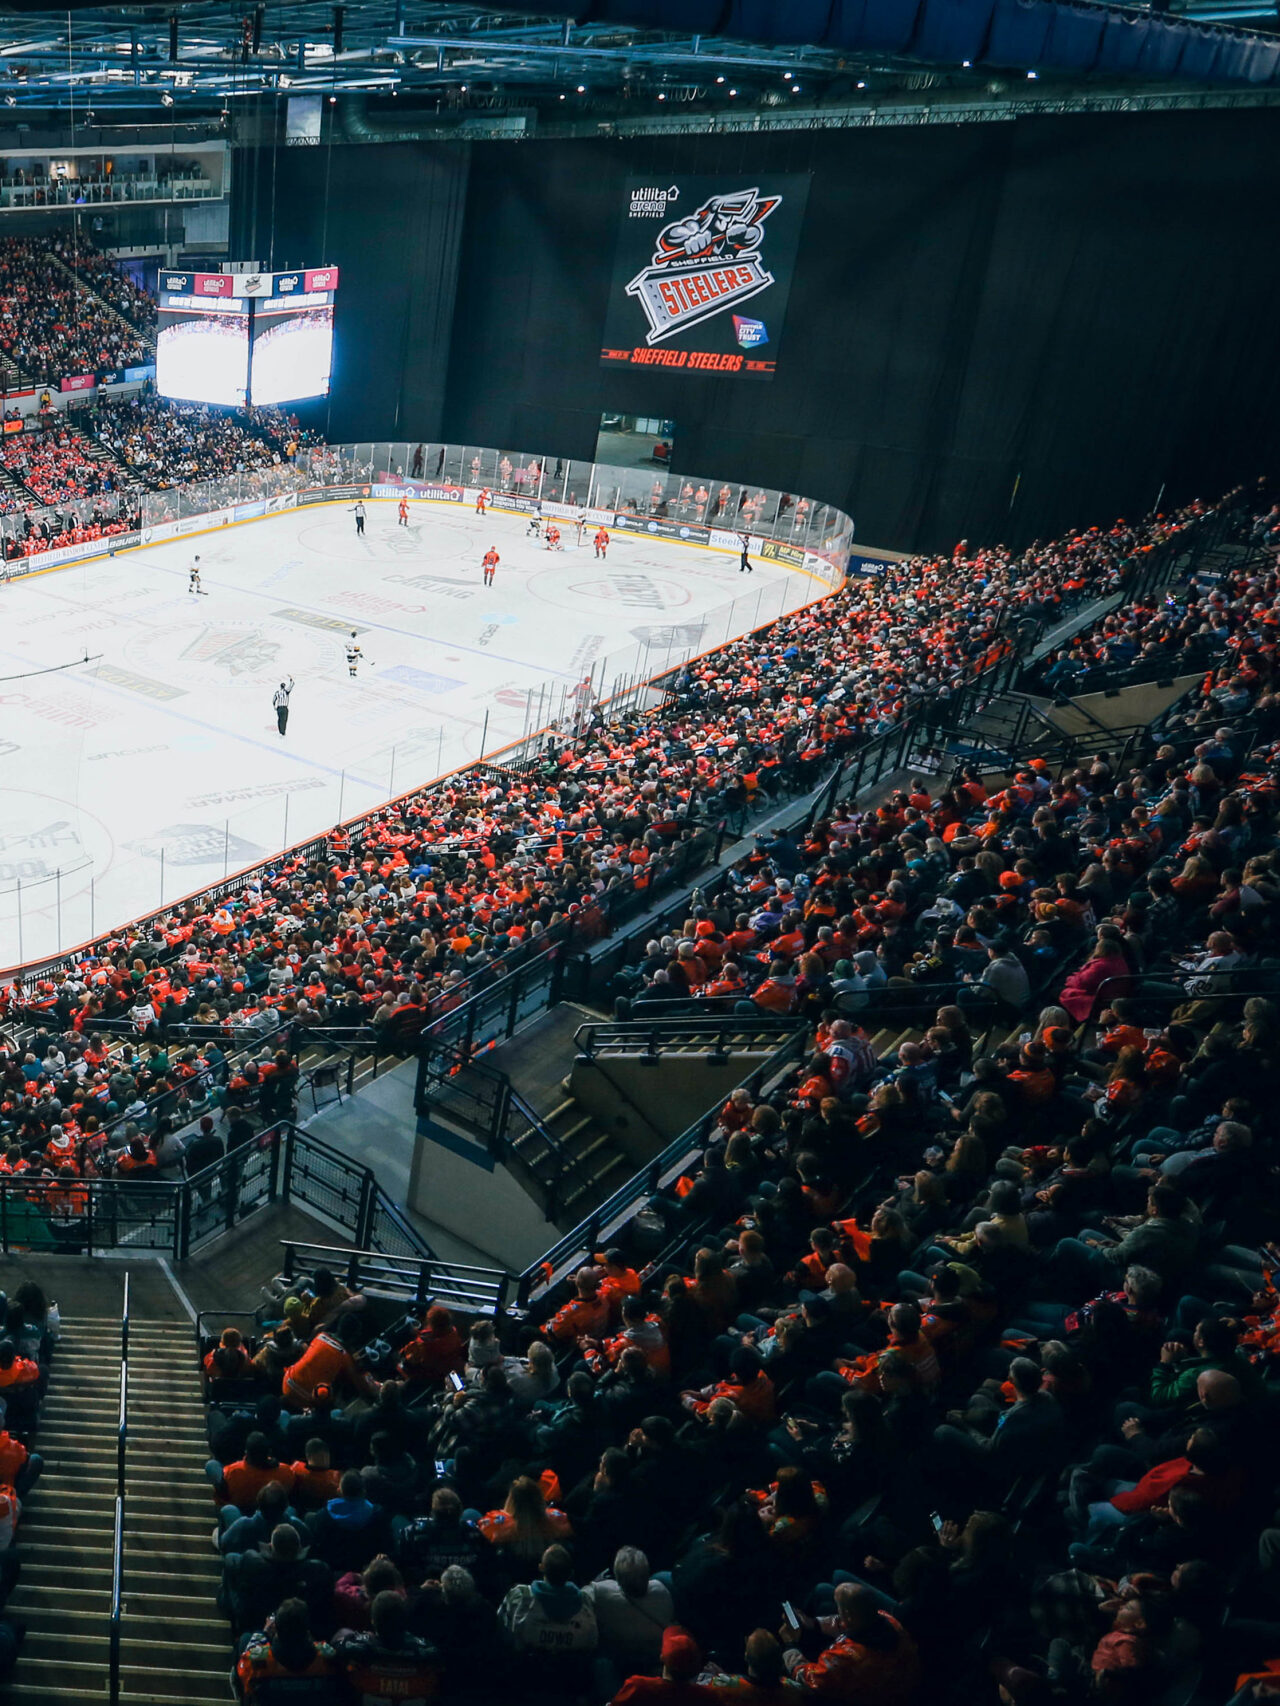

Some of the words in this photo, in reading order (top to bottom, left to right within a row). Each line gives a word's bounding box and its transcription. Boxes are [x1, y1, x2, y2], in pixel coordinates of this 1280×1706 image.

[631, 188, 667, 200] utilita
[629, 201, 667, 211] arena
[670, 253, 734, 268] SHEFFIELD
[658, 266, 754, 316] STEELERS
[738, 333, 761, 341] TRUST
[630, 347, 687, 366] SHEFFIELD
[687, 351, 744, 372] STEELERS
[375, 484, 406, 498] utilita
[420, 486, 450, 500] utilita
[109, 534, 141, 548] BAUER
[30, 550, 61, 565] SHEFFIELD
[62, 544, 86, 559] WINDOW
[381, 574, 475, 599] CARLING
